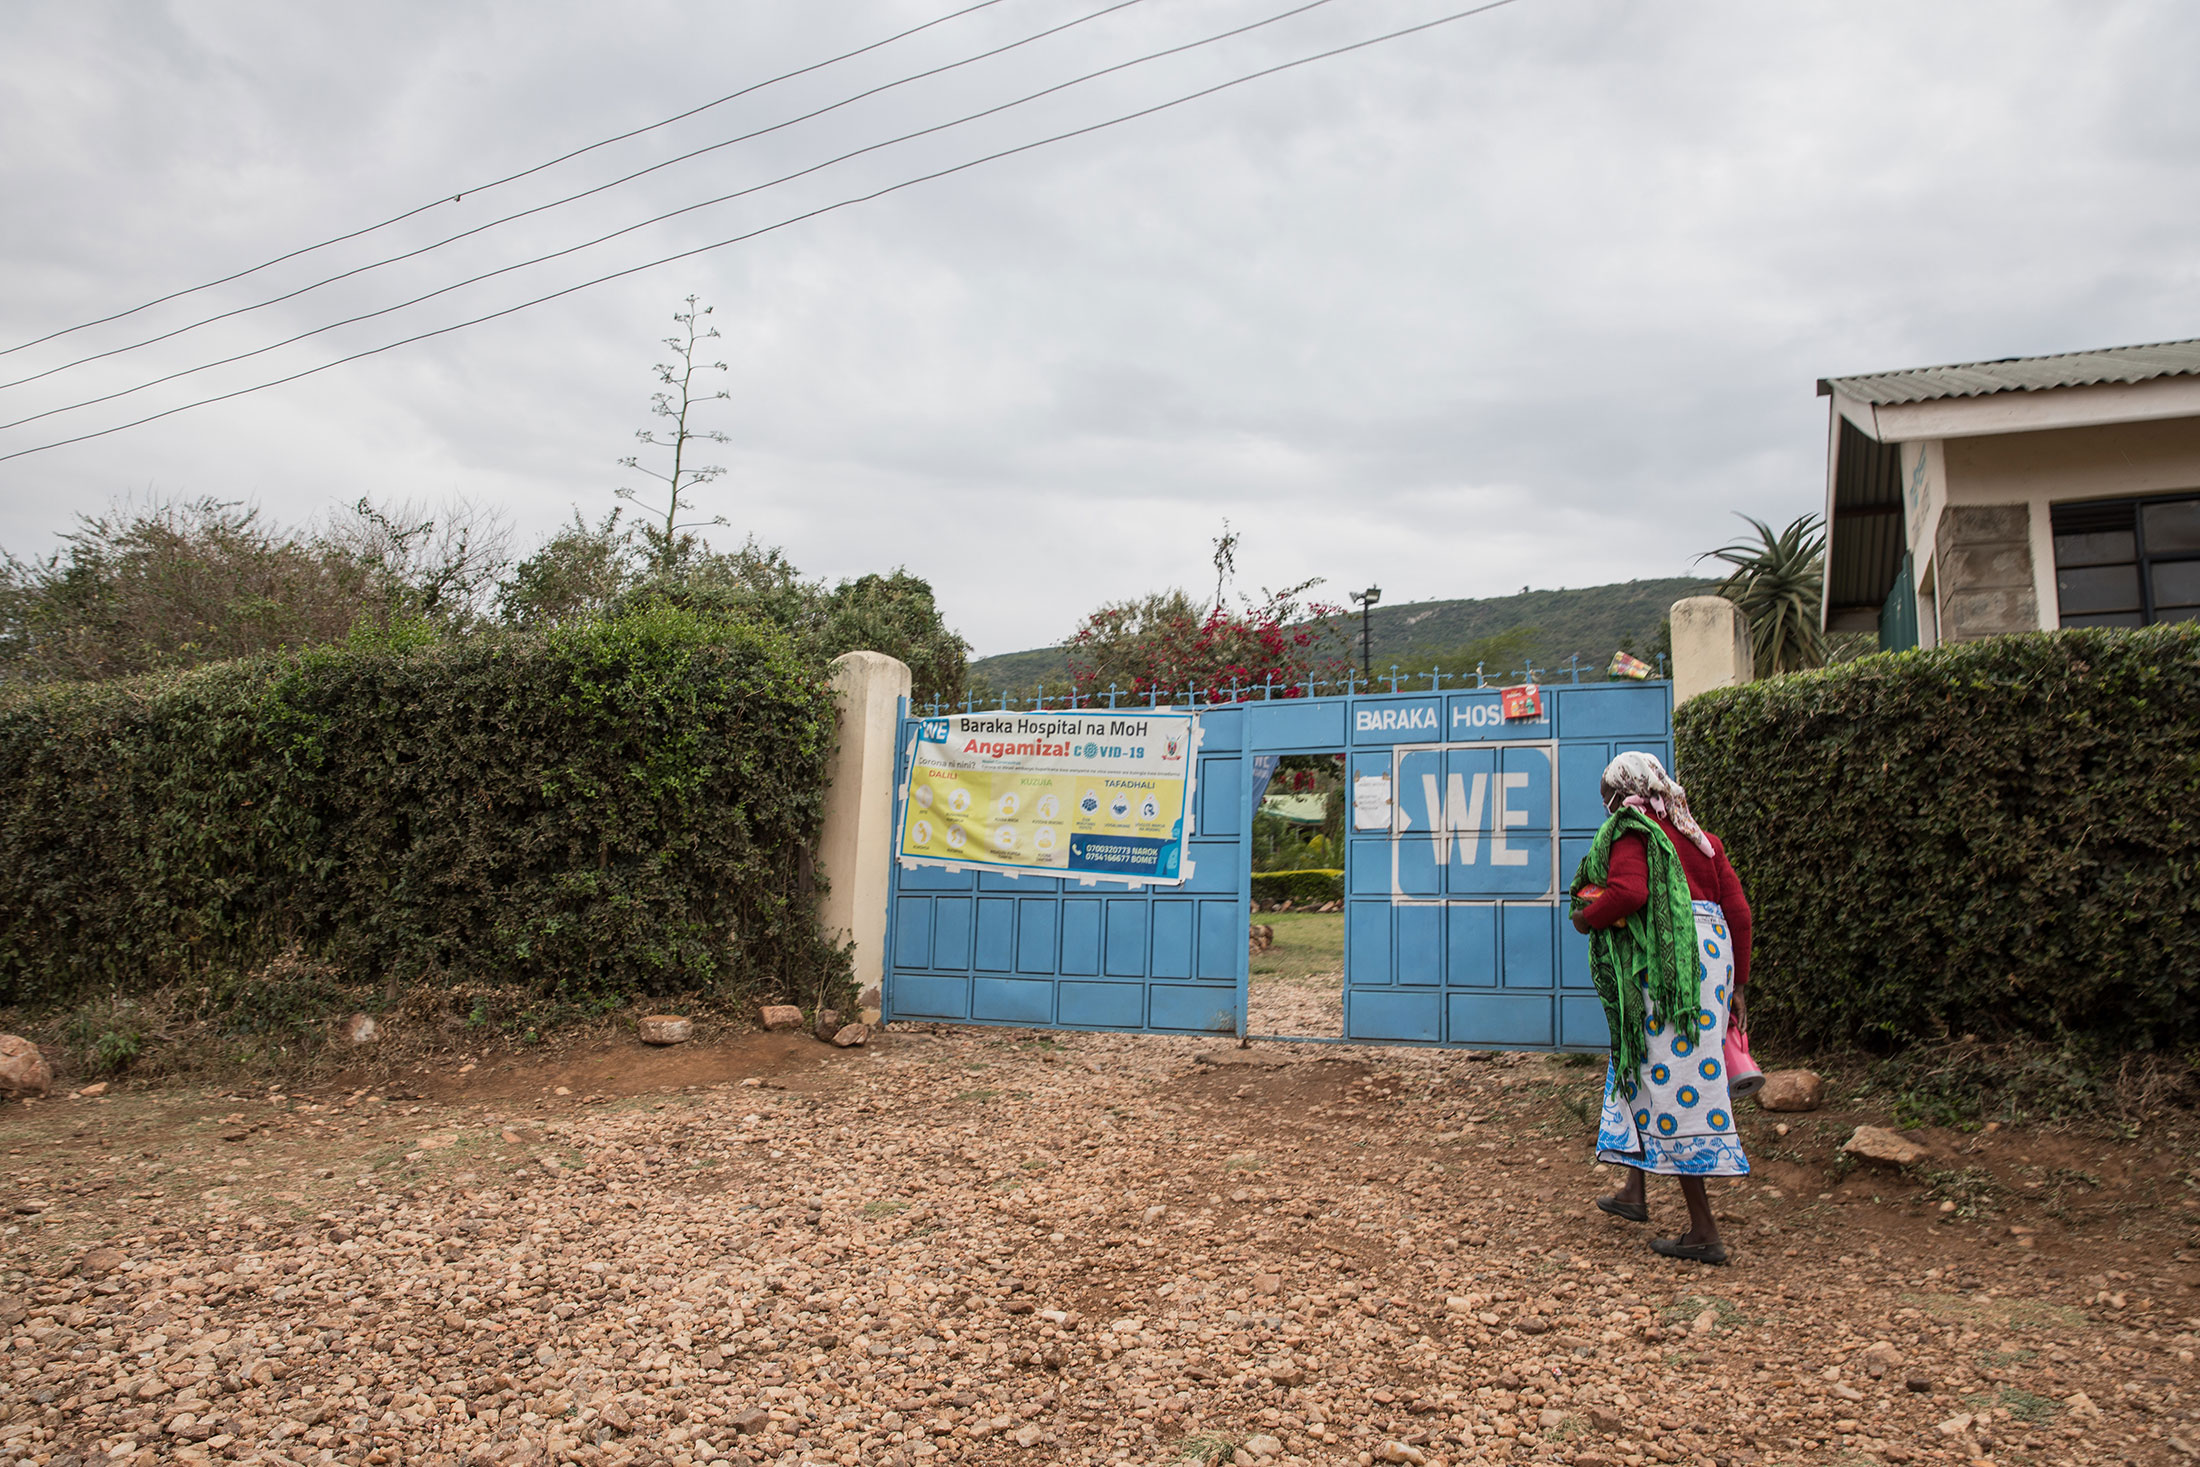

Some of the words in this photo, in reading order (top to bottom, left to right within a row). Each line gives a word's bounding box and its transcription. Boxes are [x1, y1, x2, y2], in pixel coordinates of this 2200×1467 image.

[961, 718, 1012, 733] Baraka
[1018, 719, 1081, 738] Hospital
[1087, 724, 1105, 736] na
[1110, 721, 1148, 737] MoH
[1356, 707, 1438, 731] BARAKA
[963, 738, 1071, 758] Angamiza!
[1105, 780, 1155, 789] TAFADHALI
[1422, 772, 1528, 866] WE
[1131, 855, 1158, 865] BOMET
[1132, 847, 1158, 857] NAROK
